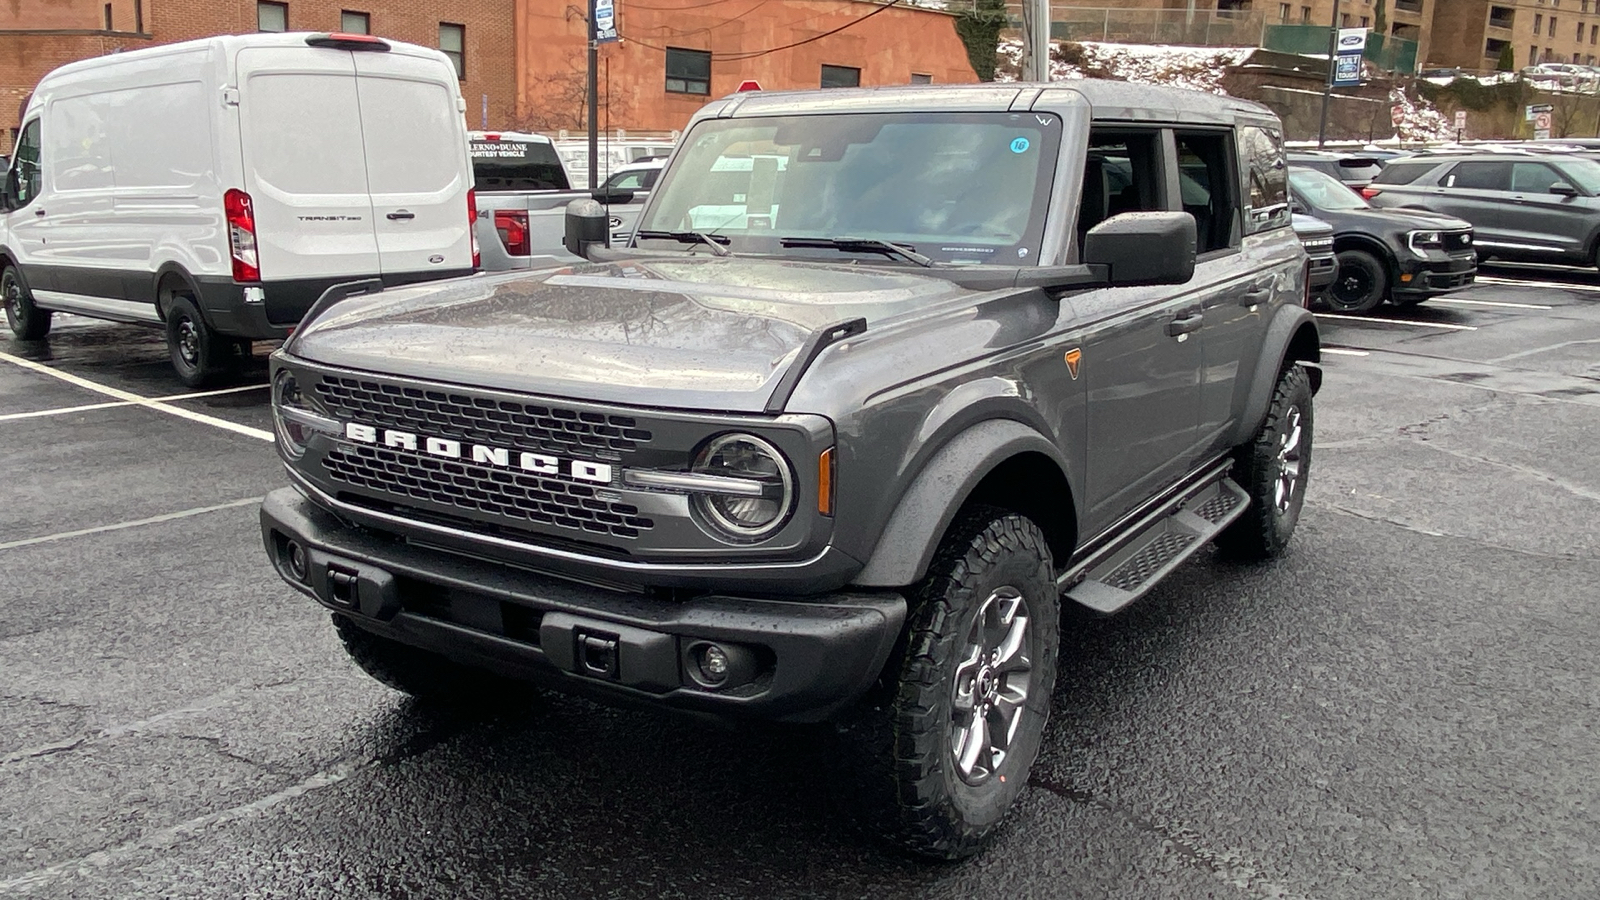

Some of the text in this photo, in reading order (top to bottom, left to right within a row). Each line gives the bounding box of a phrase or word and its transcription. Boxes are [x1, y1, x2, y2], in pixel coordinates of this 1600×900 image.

[1339, 56, 1358, 65] BUILT
[498, 150, 525, 158] VEHICLE
[346, 422, 612, 483] BRONCO
